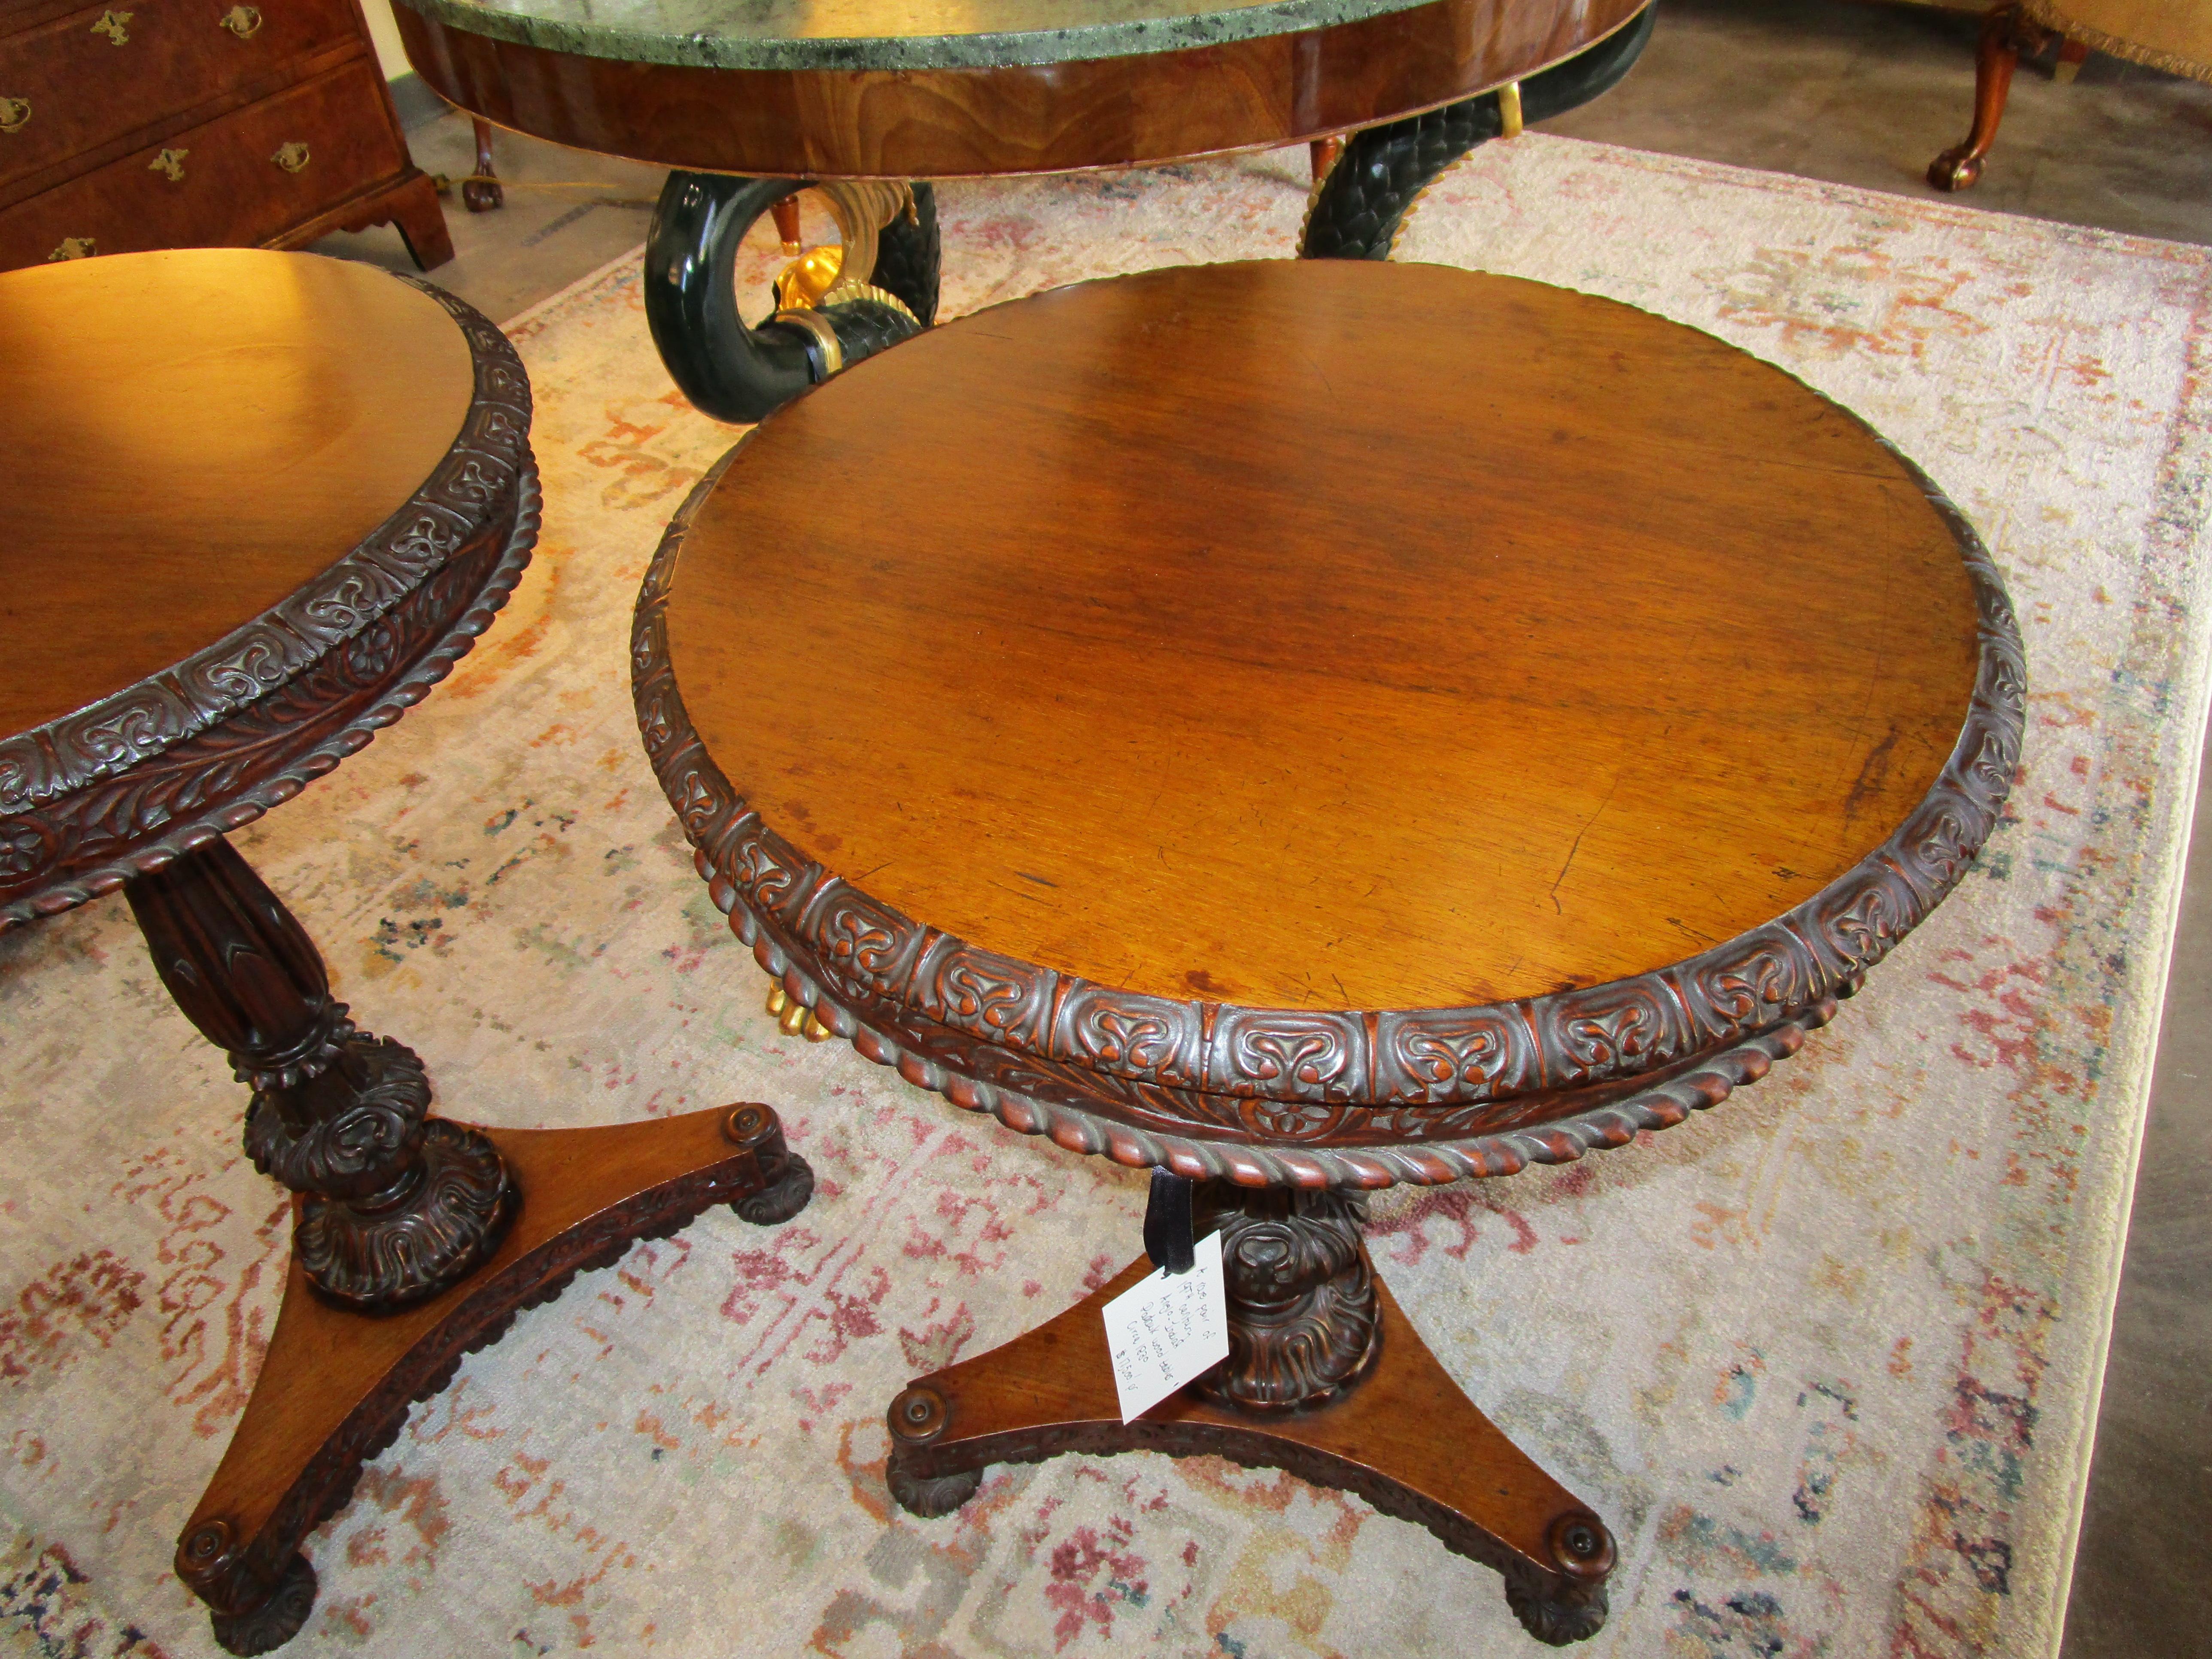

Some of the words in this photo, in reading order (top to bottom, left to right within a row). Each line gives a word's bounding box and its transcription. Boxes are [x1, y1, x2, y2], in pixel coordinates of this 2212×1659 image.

[1196, 1267, 1207, 1277] A
[1197, 1282, 1207, 1300] rare
[1179, 1304, 1192, 1341] century
[1195, 1304, 1210, 1322] pair
[1127, 1321, 1140, 1345] Circa
[1135, 1344, 1149, 1363] 1830
[1202, 1331, 1216, 1340] of
[1152, 1338, 1168, 1358] wood
[1159, 1359, 1173, 1381] tables
